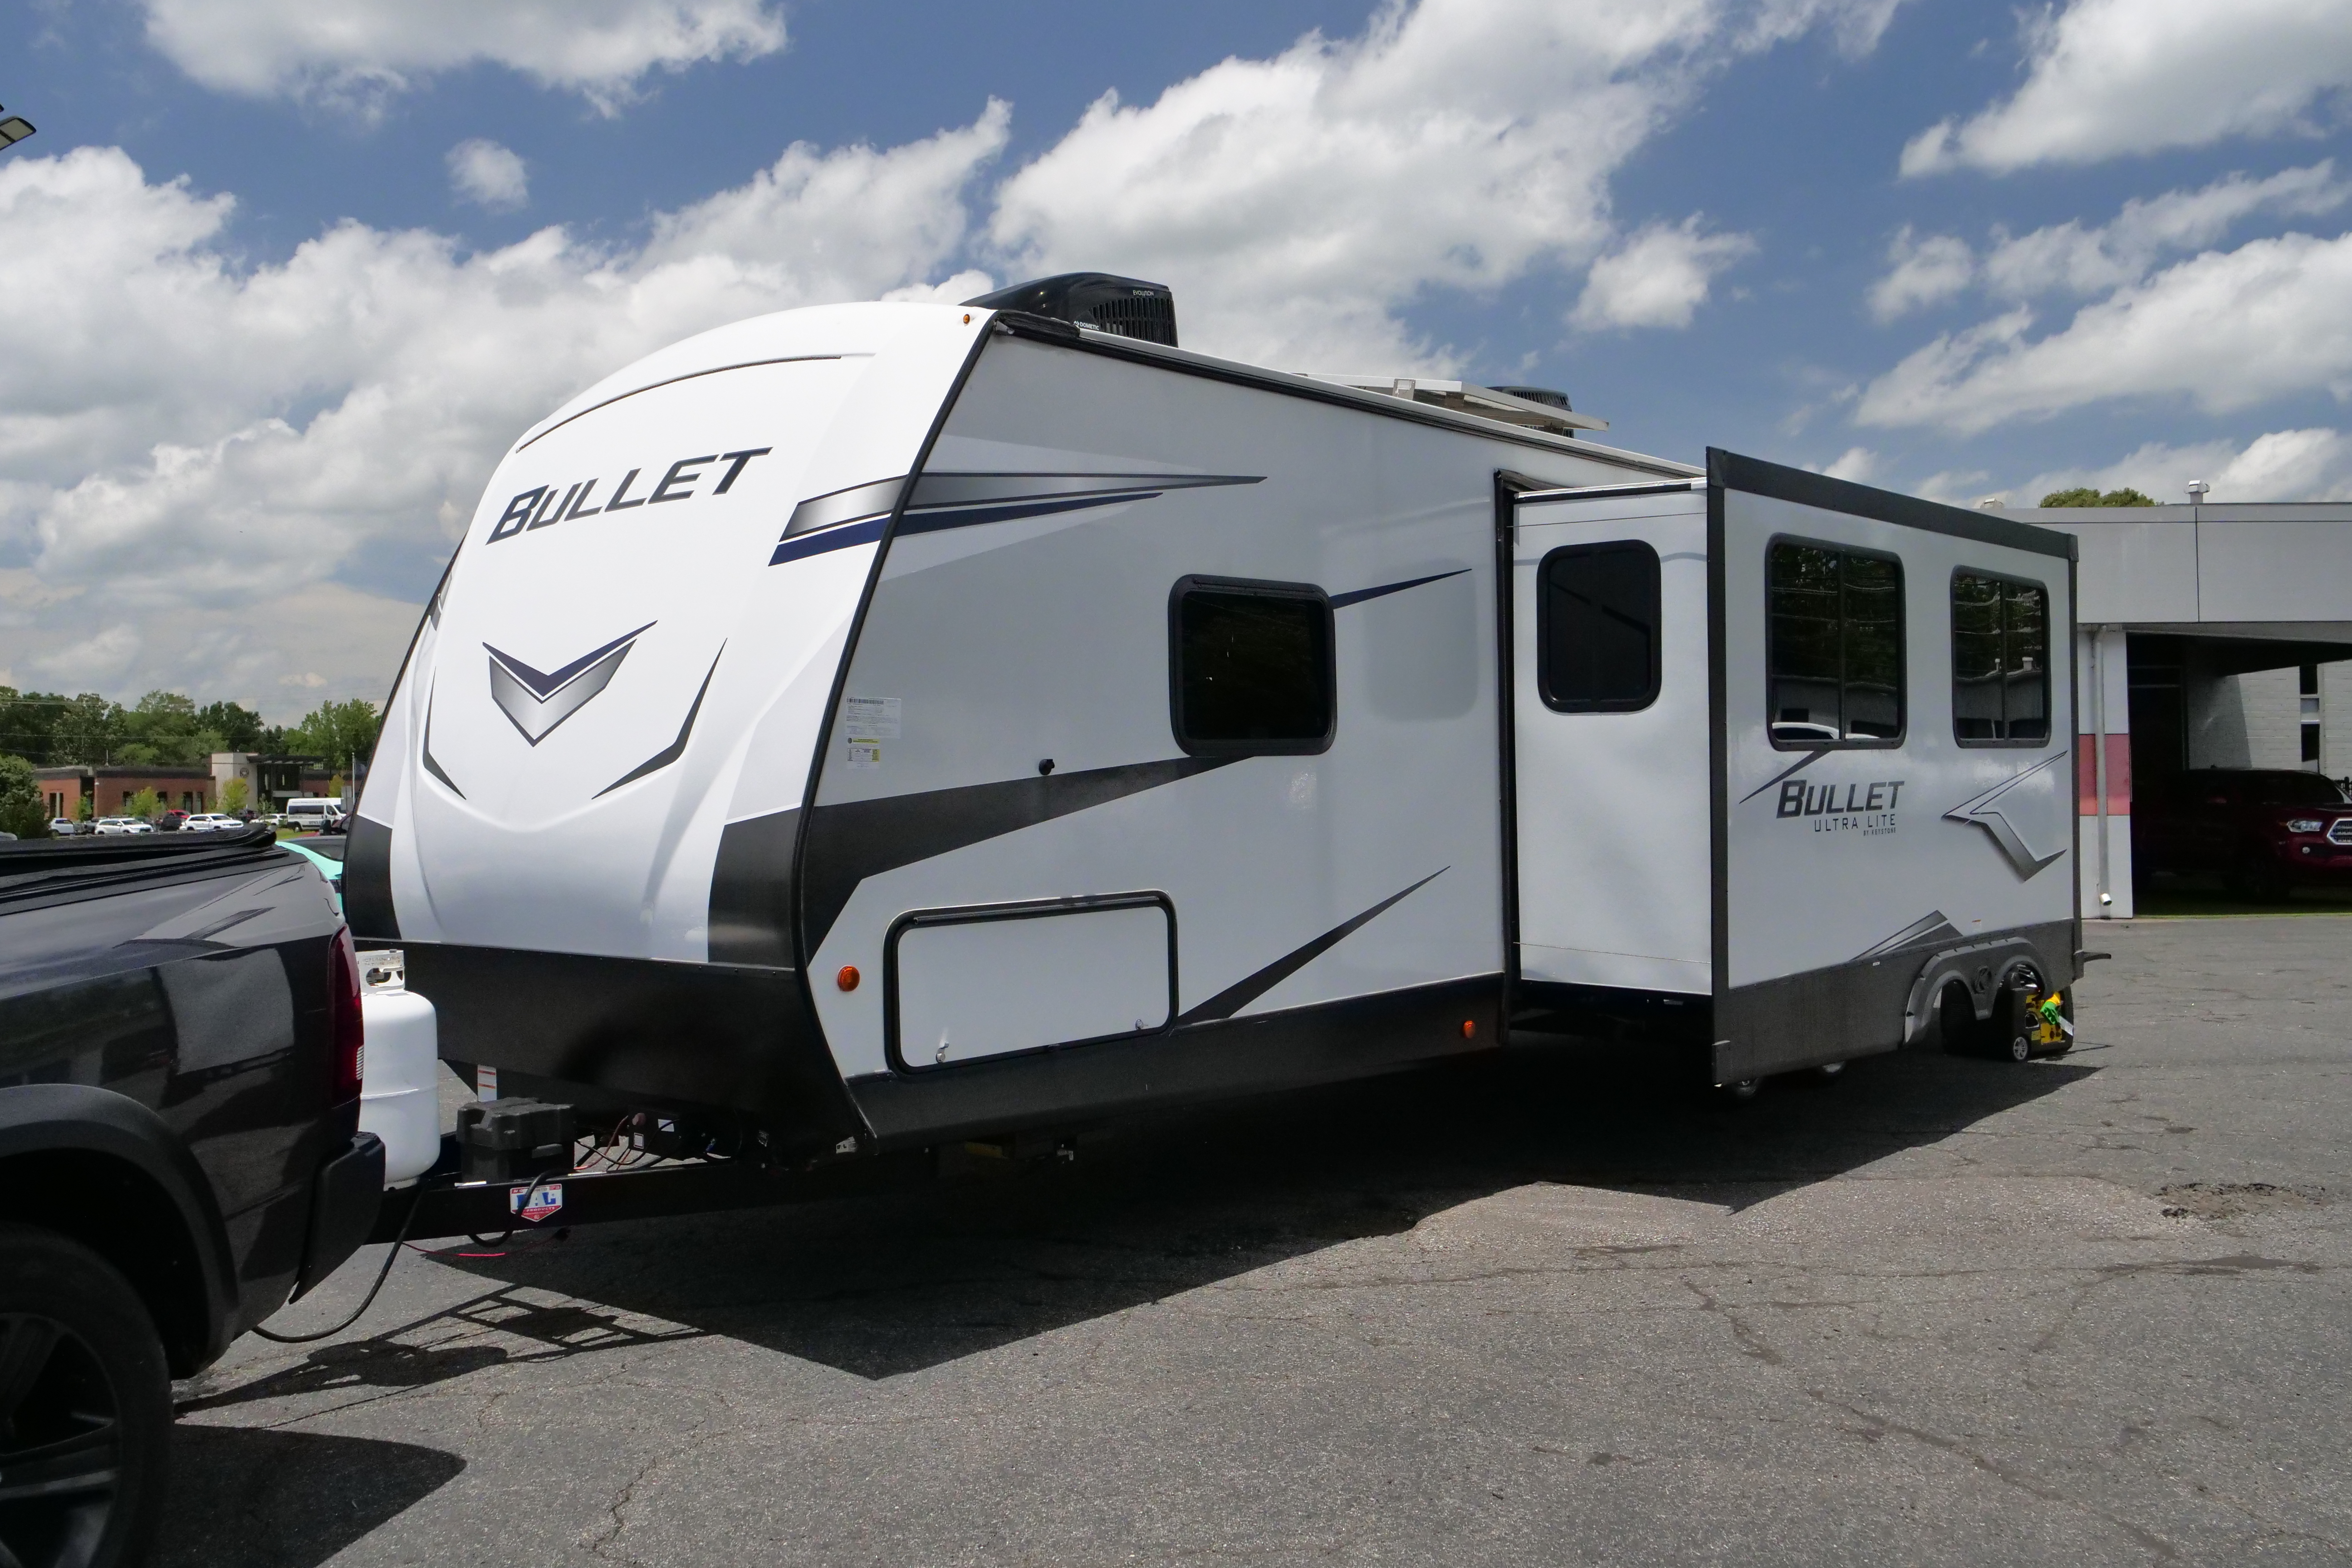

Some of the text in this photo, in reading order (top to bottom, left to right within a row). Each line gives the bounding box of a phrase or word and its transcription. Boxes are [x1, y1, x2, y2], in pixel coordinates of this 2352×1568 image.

[1080, 321, 1099, 331] DOMETIC
[485, 446, 774, 545] BULLET
[1776, 779, 1905, 819] BULLET
[1814, 813, 1896, 833] ULTRA LITE
[1872, 827, 1896, 835] KEYSTONE
